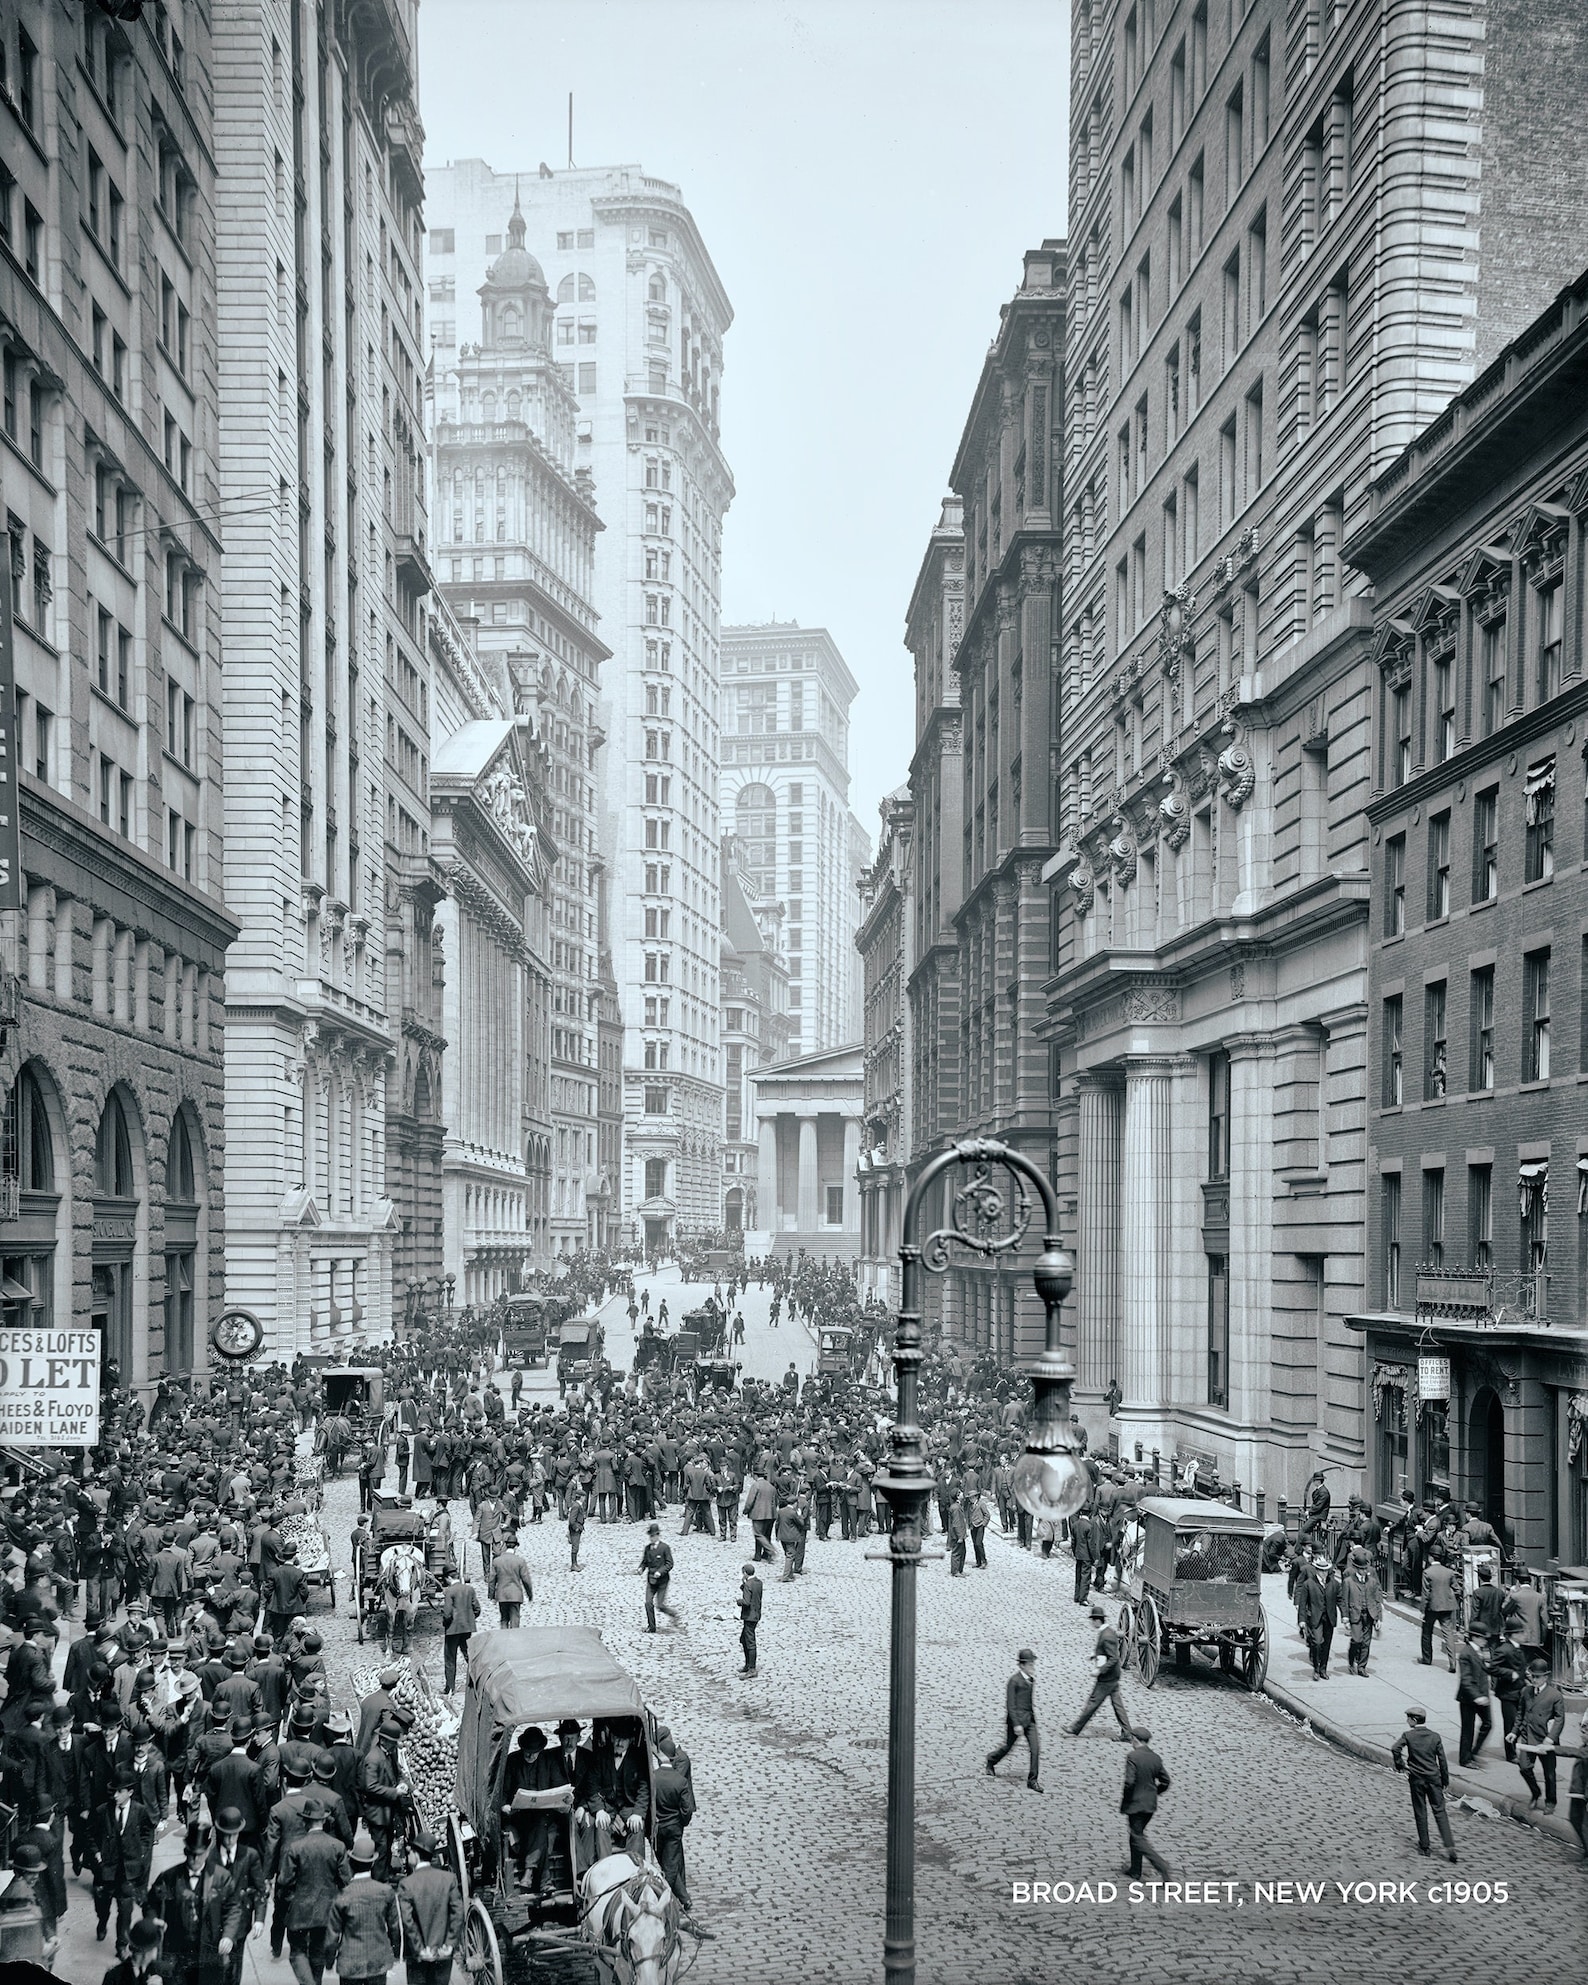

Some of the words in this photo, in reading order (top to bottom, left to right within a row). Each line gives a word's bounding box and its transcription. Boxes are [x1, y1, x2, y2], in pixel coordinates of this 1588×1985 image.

[0, 1333, 32, 1353] CES
[48, 1333, 96, 1353] LOFTS
[19, 1358, 96, 1388] LET
[1420, 1366, 1429, 1375] TO
[33, 1400, 45, 1417] &
[48, 1400, 94, 1417] FLOYD
[0, 1422, 42, 1434] AIDEN
[50, 1422, 88, 1434] LANE
